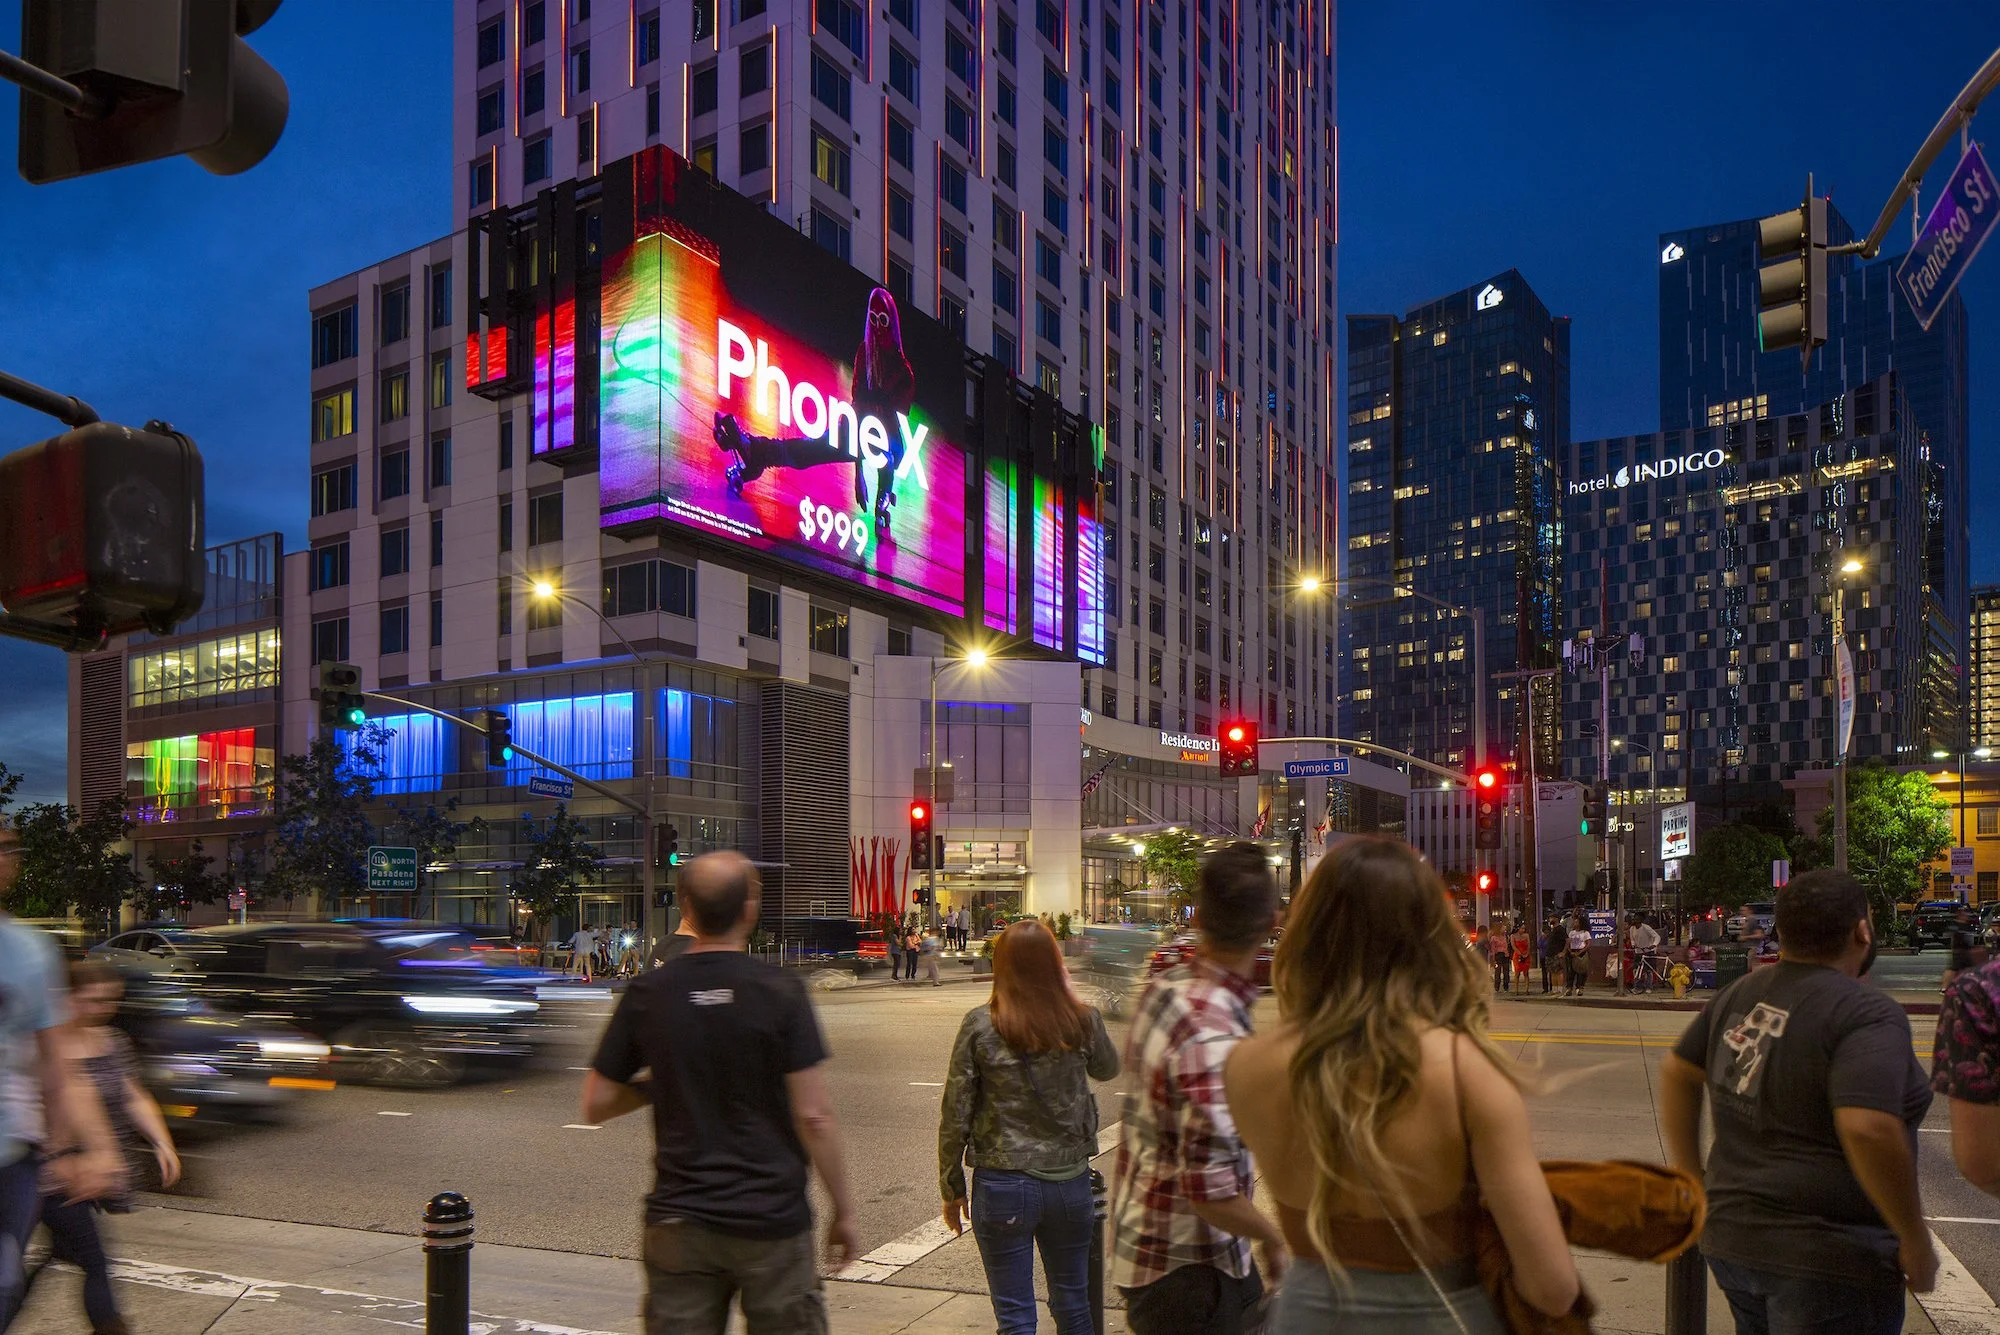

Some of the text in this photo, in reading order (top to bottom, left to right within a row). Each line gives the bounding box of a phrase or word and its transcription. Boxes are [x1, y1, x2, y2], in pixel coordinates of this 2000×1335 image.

[1907, 168, 1990, 307] Francisco St
[718, 317, 930, 490] Phone X
[1569, 448, 1725, 495] hotel INDIGO
[798, 495, 869, 556] $999
[1160, 731, 1211, 751] Residence
[1180, 751, 1209, 762] Marriott
[1290, 761, 1344, 775] Olympic Bl
[531, 780, 571, 794] Francisco St
[1663, 816, 1688, 832] PARKING
[374, 856, 386, 864] 110
[371, 869, 414, 878] Pasadena
